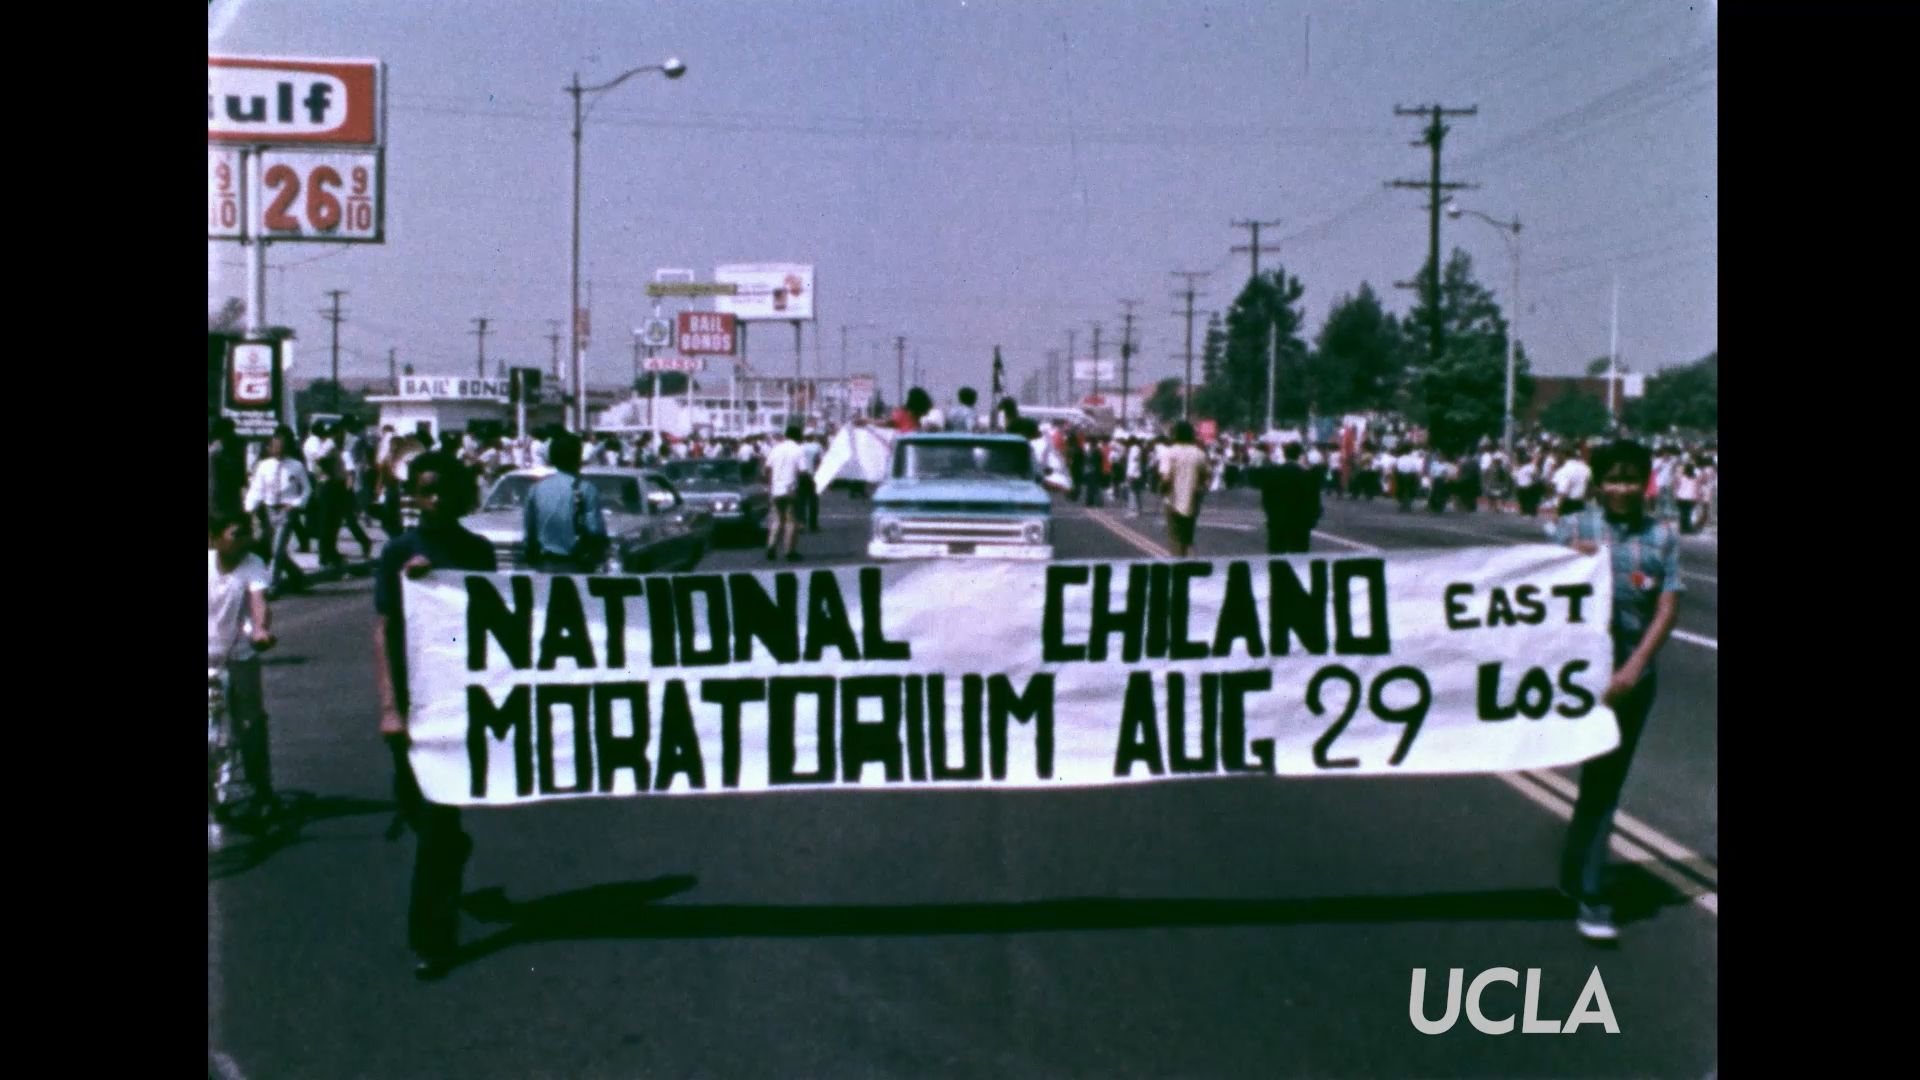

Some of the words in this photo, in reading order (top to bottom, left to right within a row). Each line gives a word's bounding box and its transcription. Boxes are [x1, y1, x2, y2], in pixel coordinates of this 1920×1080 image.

[208, 80, 333, 123] ulf
[264, 164, 342, 231] 26
[352, 166, 368, 194] 9
[347, 202, 371, 231] 10
[681, 334, 732, 352] BONDS
[689, 315, 722, 333] BAIL
[465, 567, 911, 671] NATIONAL
[1042, 558, 1390, 663] CHICANO
[1444, 583, 1594, 630] EAST
[1477, 660, 1597, 722] LOS
[466, 671, 1055, 798] MORATORIUM
[1114, 668, 1276, 777] AUG
[1305, 664, 1432, 769] 29
